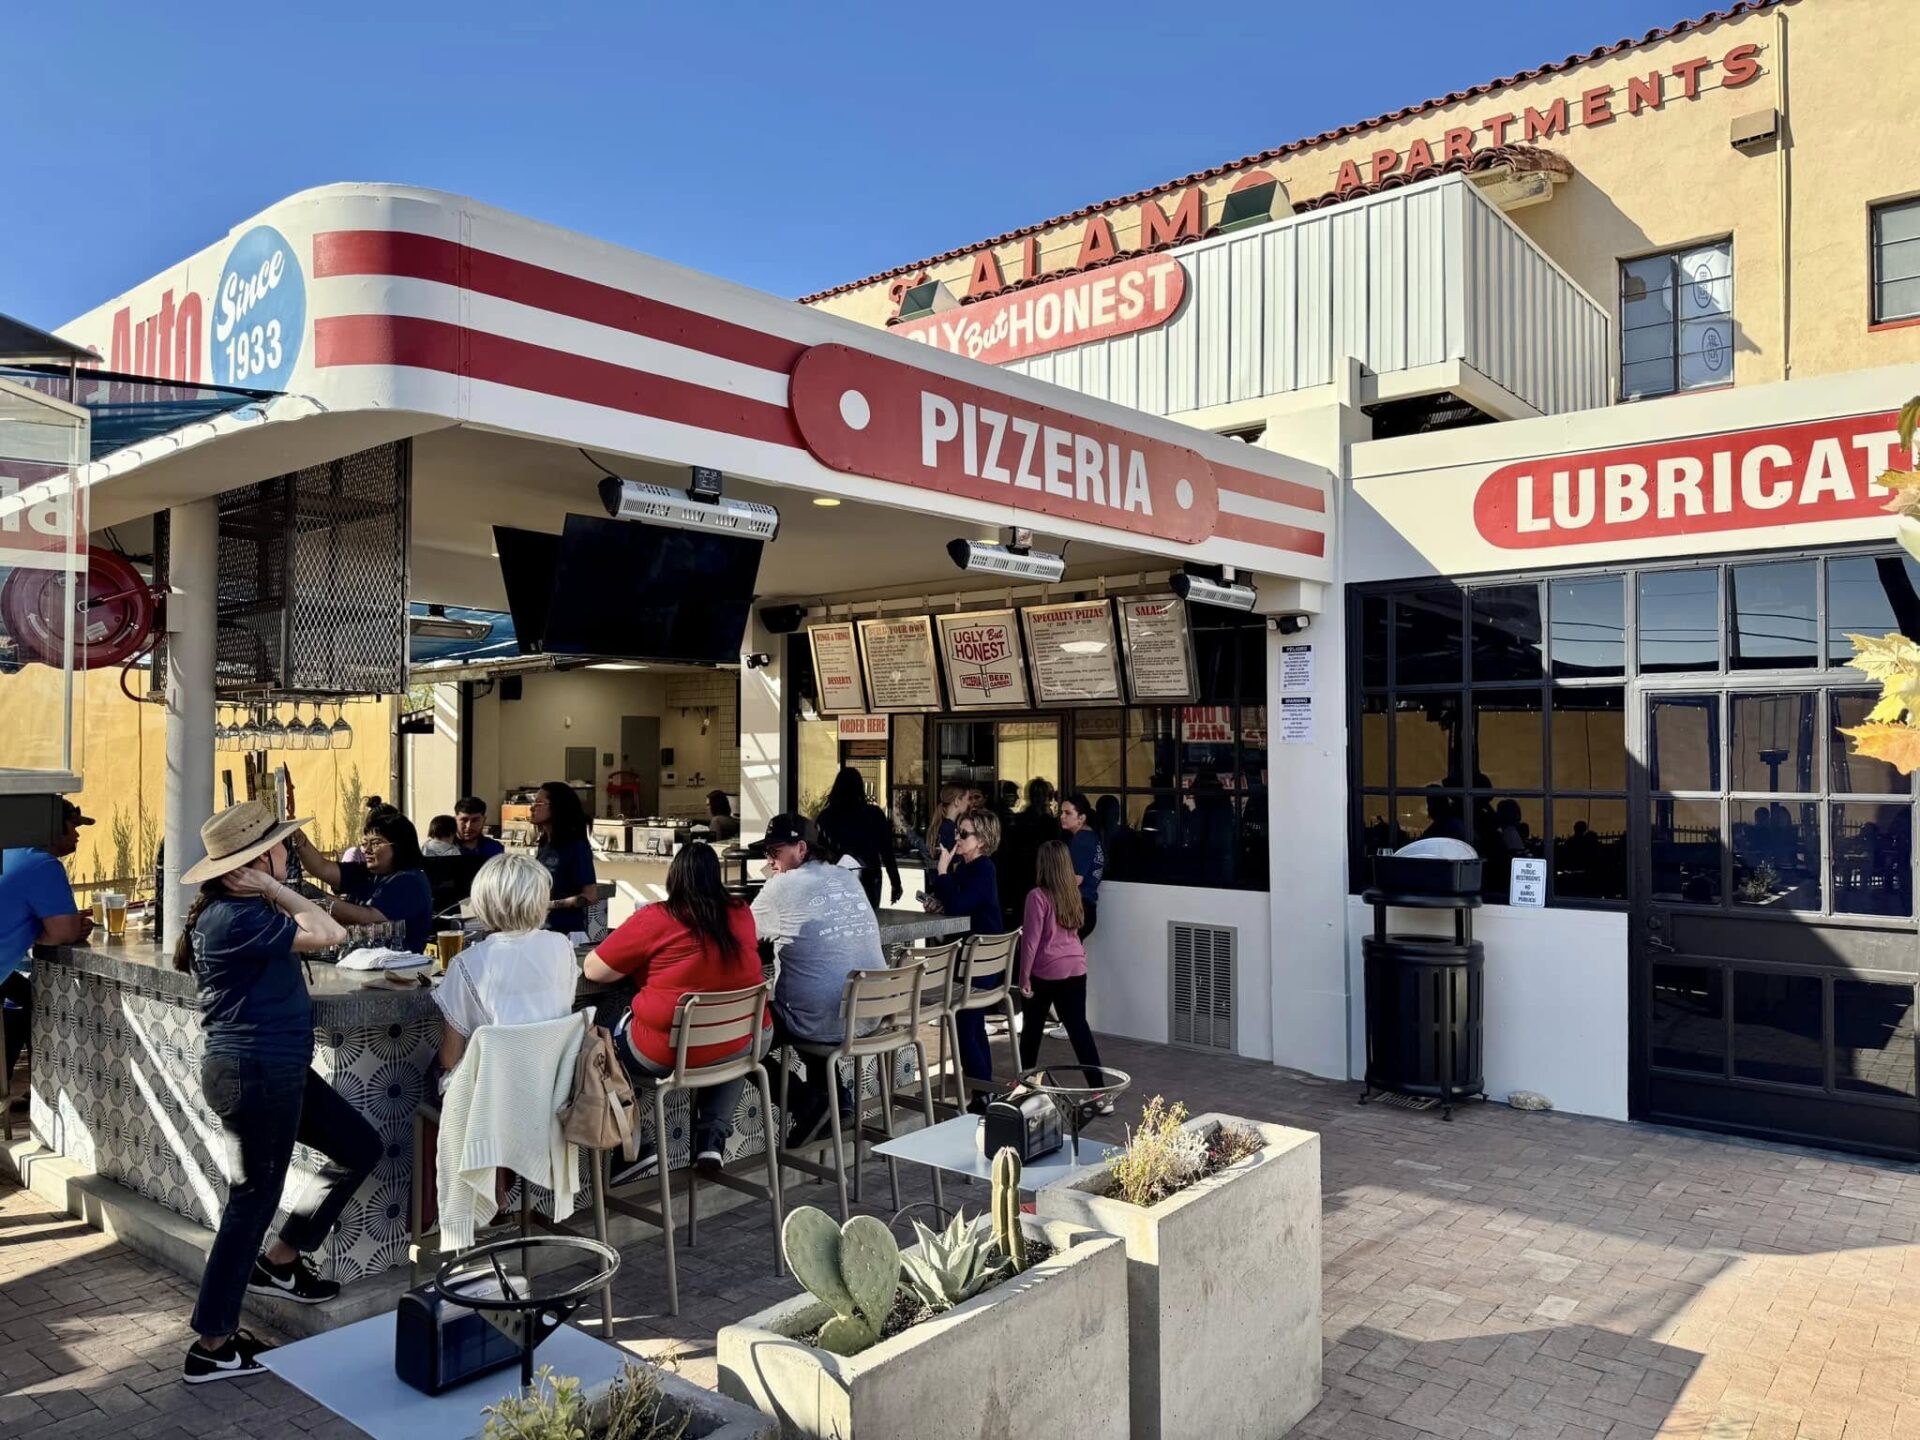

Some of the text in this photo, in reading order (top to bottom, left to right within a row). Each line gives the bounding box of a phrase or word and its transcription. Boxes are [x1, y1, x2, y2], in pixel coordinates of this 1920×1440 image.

[967, 43, 1758, 297] ALAM APARTMENTS
[216, 249, 285, 343] Since
[964, 308, 1008, 359] But
[1009, 262, 1175, 348] HONEST
[110, 289, 203, 402] Auto
[225, 318, 283, 384] 1933
[920, 390, 1153, 516] PIZZERIA
[1516, 430, 1920, 534] LUBRICAT
[954, 628, 1004, 643] UGLY But
[1032, 611, 1073, 623] SPECIALTY
[1076, 608, 1104, 619] PIZZAS
[955, 641, 1005, 661] HONEST
[988, 674, 1009, 682] BEER
[840, 718, 886, 733] ORDER HERE
[1186, 724, 1232, 740] JAN.
